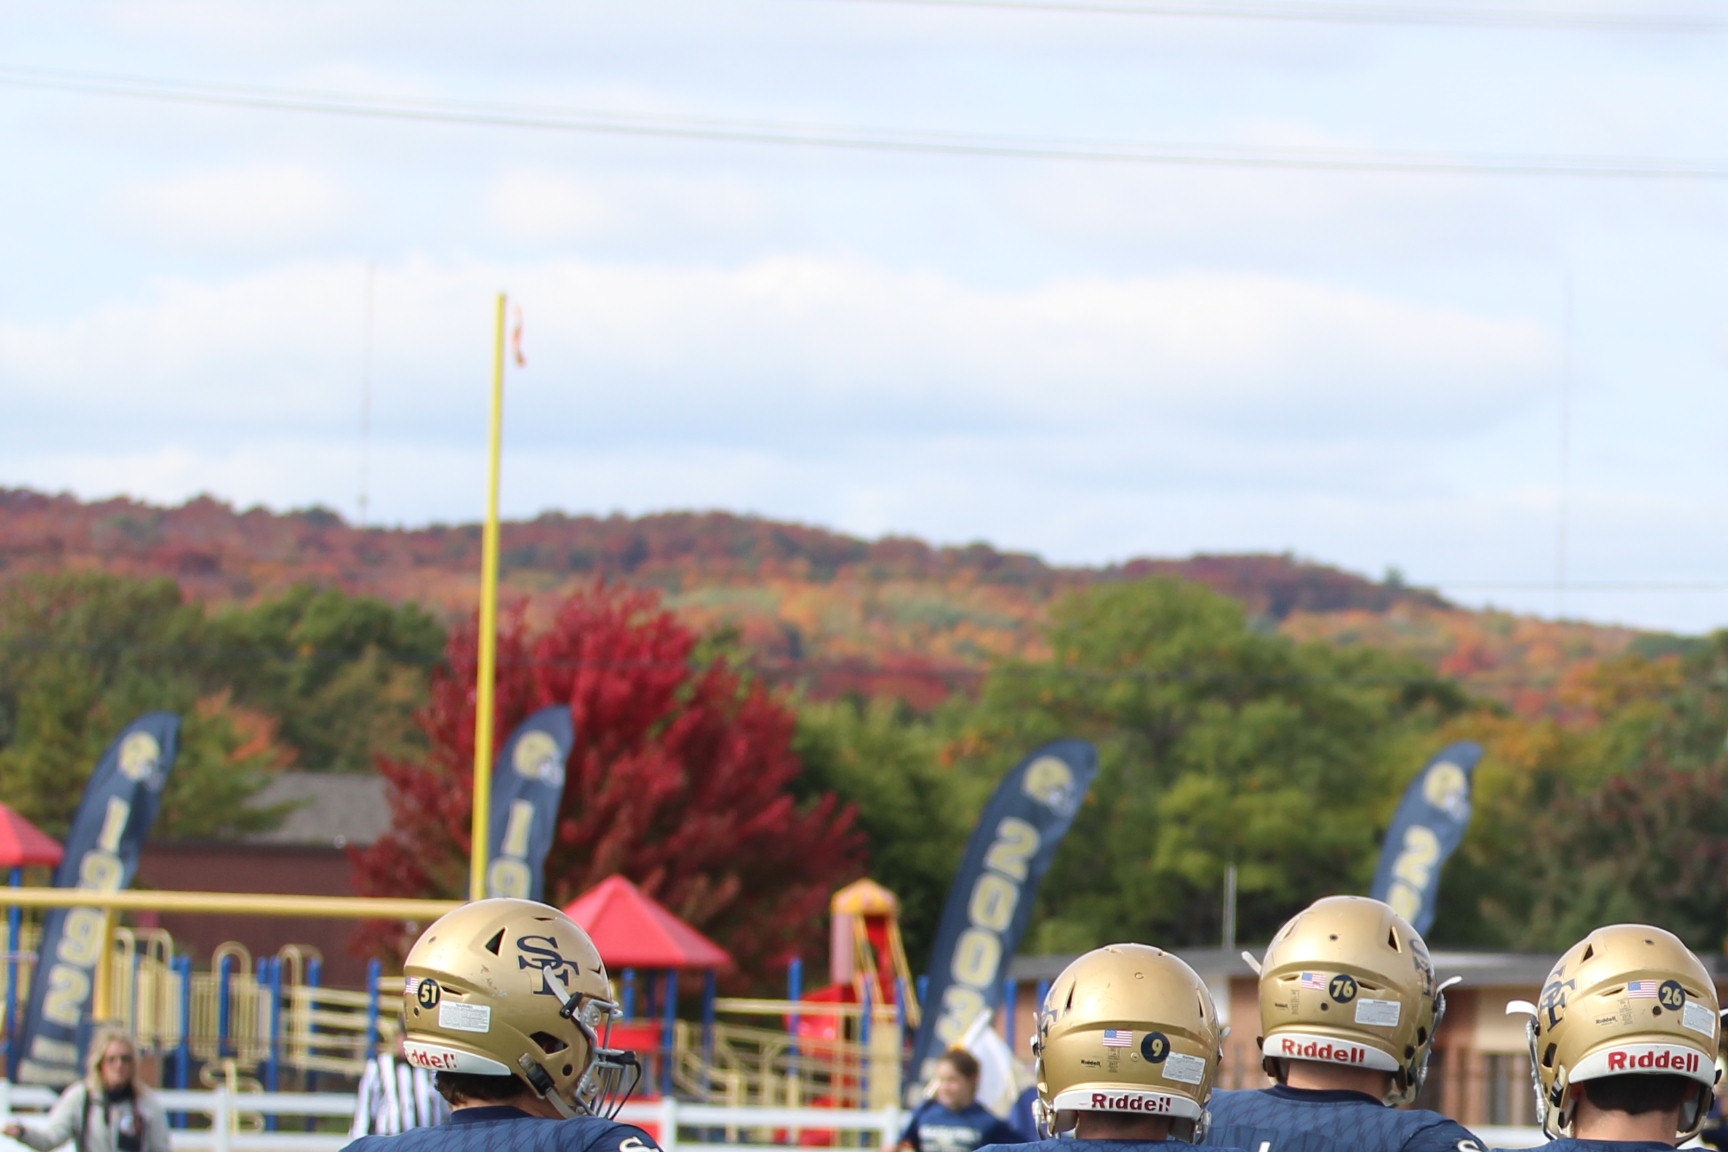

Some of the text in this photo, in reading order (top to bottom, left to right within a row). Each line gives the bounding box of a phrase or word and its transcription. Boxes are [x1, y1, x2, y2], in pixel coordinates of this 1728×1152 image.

[934, 816, 1040, 1047] 2003
[420, 984, 438, 1004] 51
[1332, 979, 1354, 999] 76
[1662, 986, 1682, 1007] 26
[1151, 1038, 1164, 1057] 9
[1281, 1038, 1366, 1063] Riddell
[1608, 1050, 1700, 1073] Riddell
[1091, 1093, 1172, 1113] Riddell
